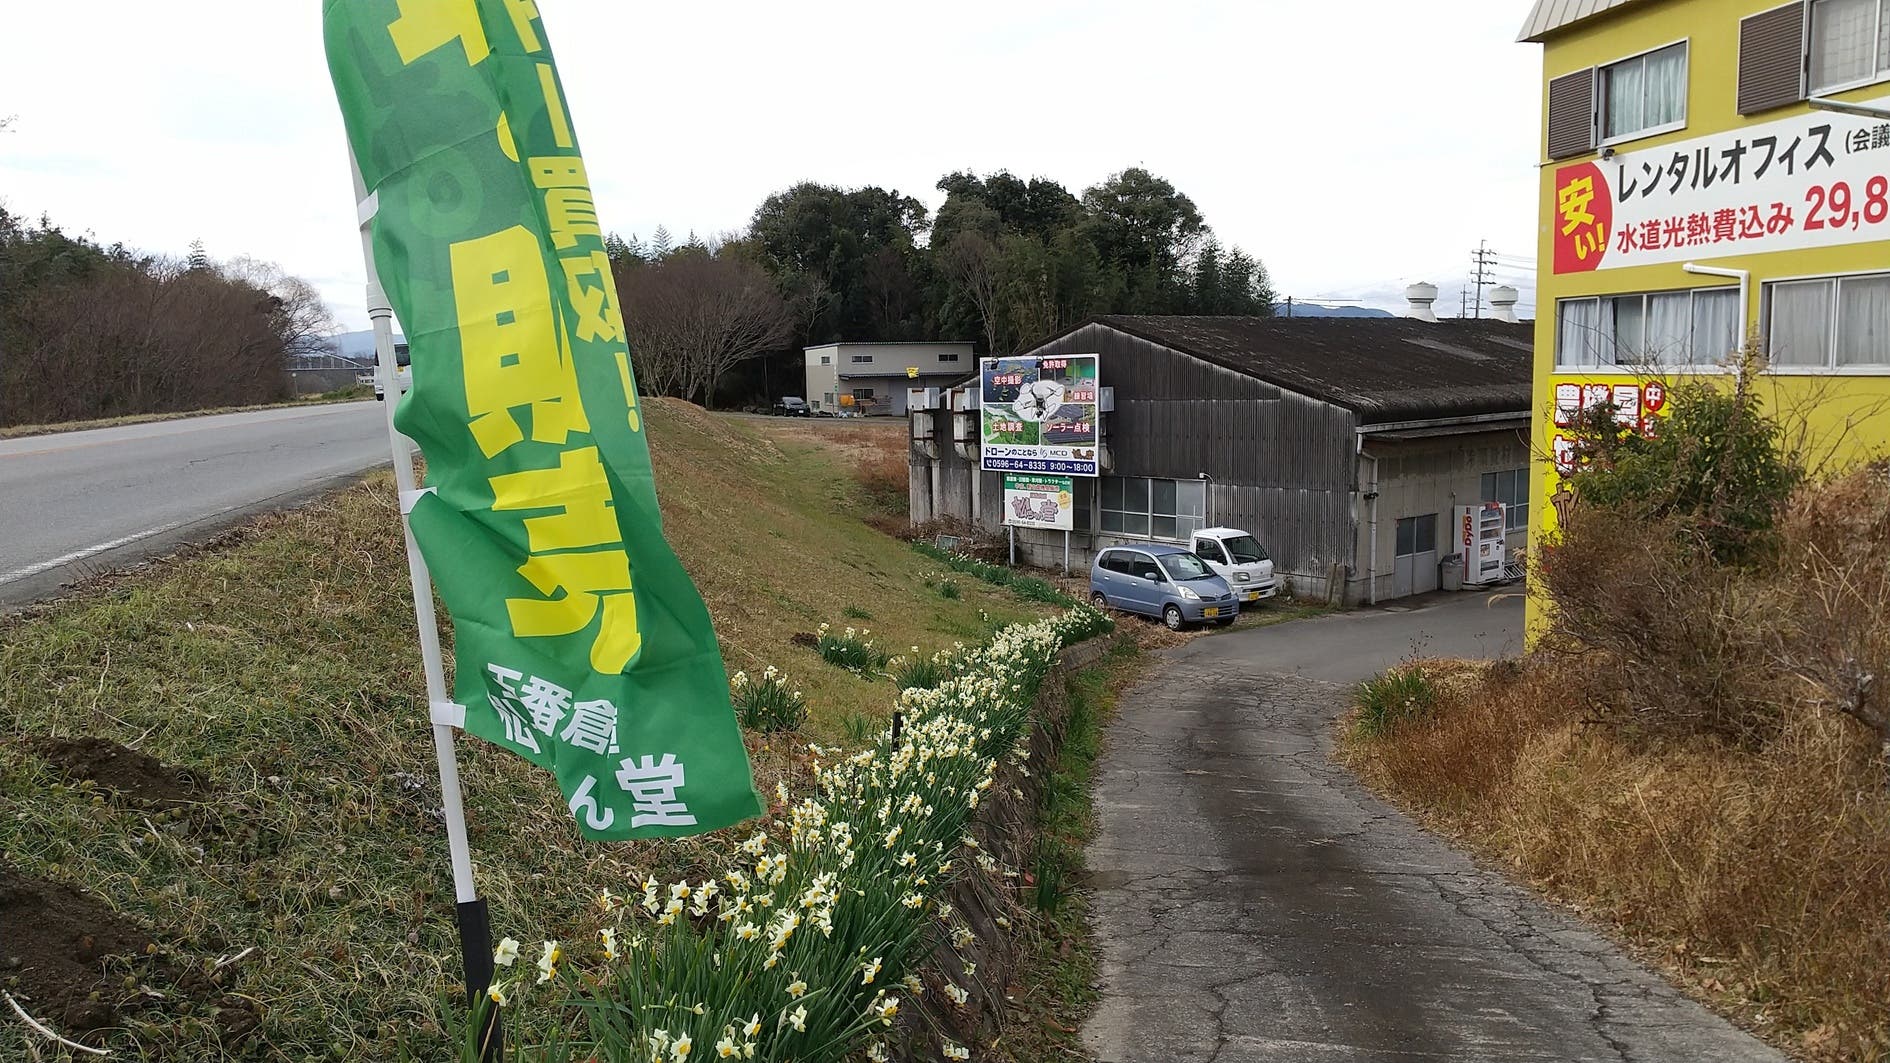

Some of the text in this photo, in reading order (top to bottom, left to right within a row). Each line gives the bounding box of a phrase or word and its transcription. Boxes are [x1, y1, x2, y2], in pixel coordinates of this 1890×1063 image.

[1617, 123, 1836, 204] レンタルオフィス
[1616, 175, 1889, 255] 水道光熱費込み 29,8
[993, 375, 1022, 386] 空中撮影
[992, 421, 1024, 432] 土地調査
[1046, 422, 1091, 433] ソーラー点検
[985, 447, 1038, 457] ドローンのことなら
[992, 459, 1047, 471] 0596-64-8335
[1464, 515, 1474, 547] DyDo
